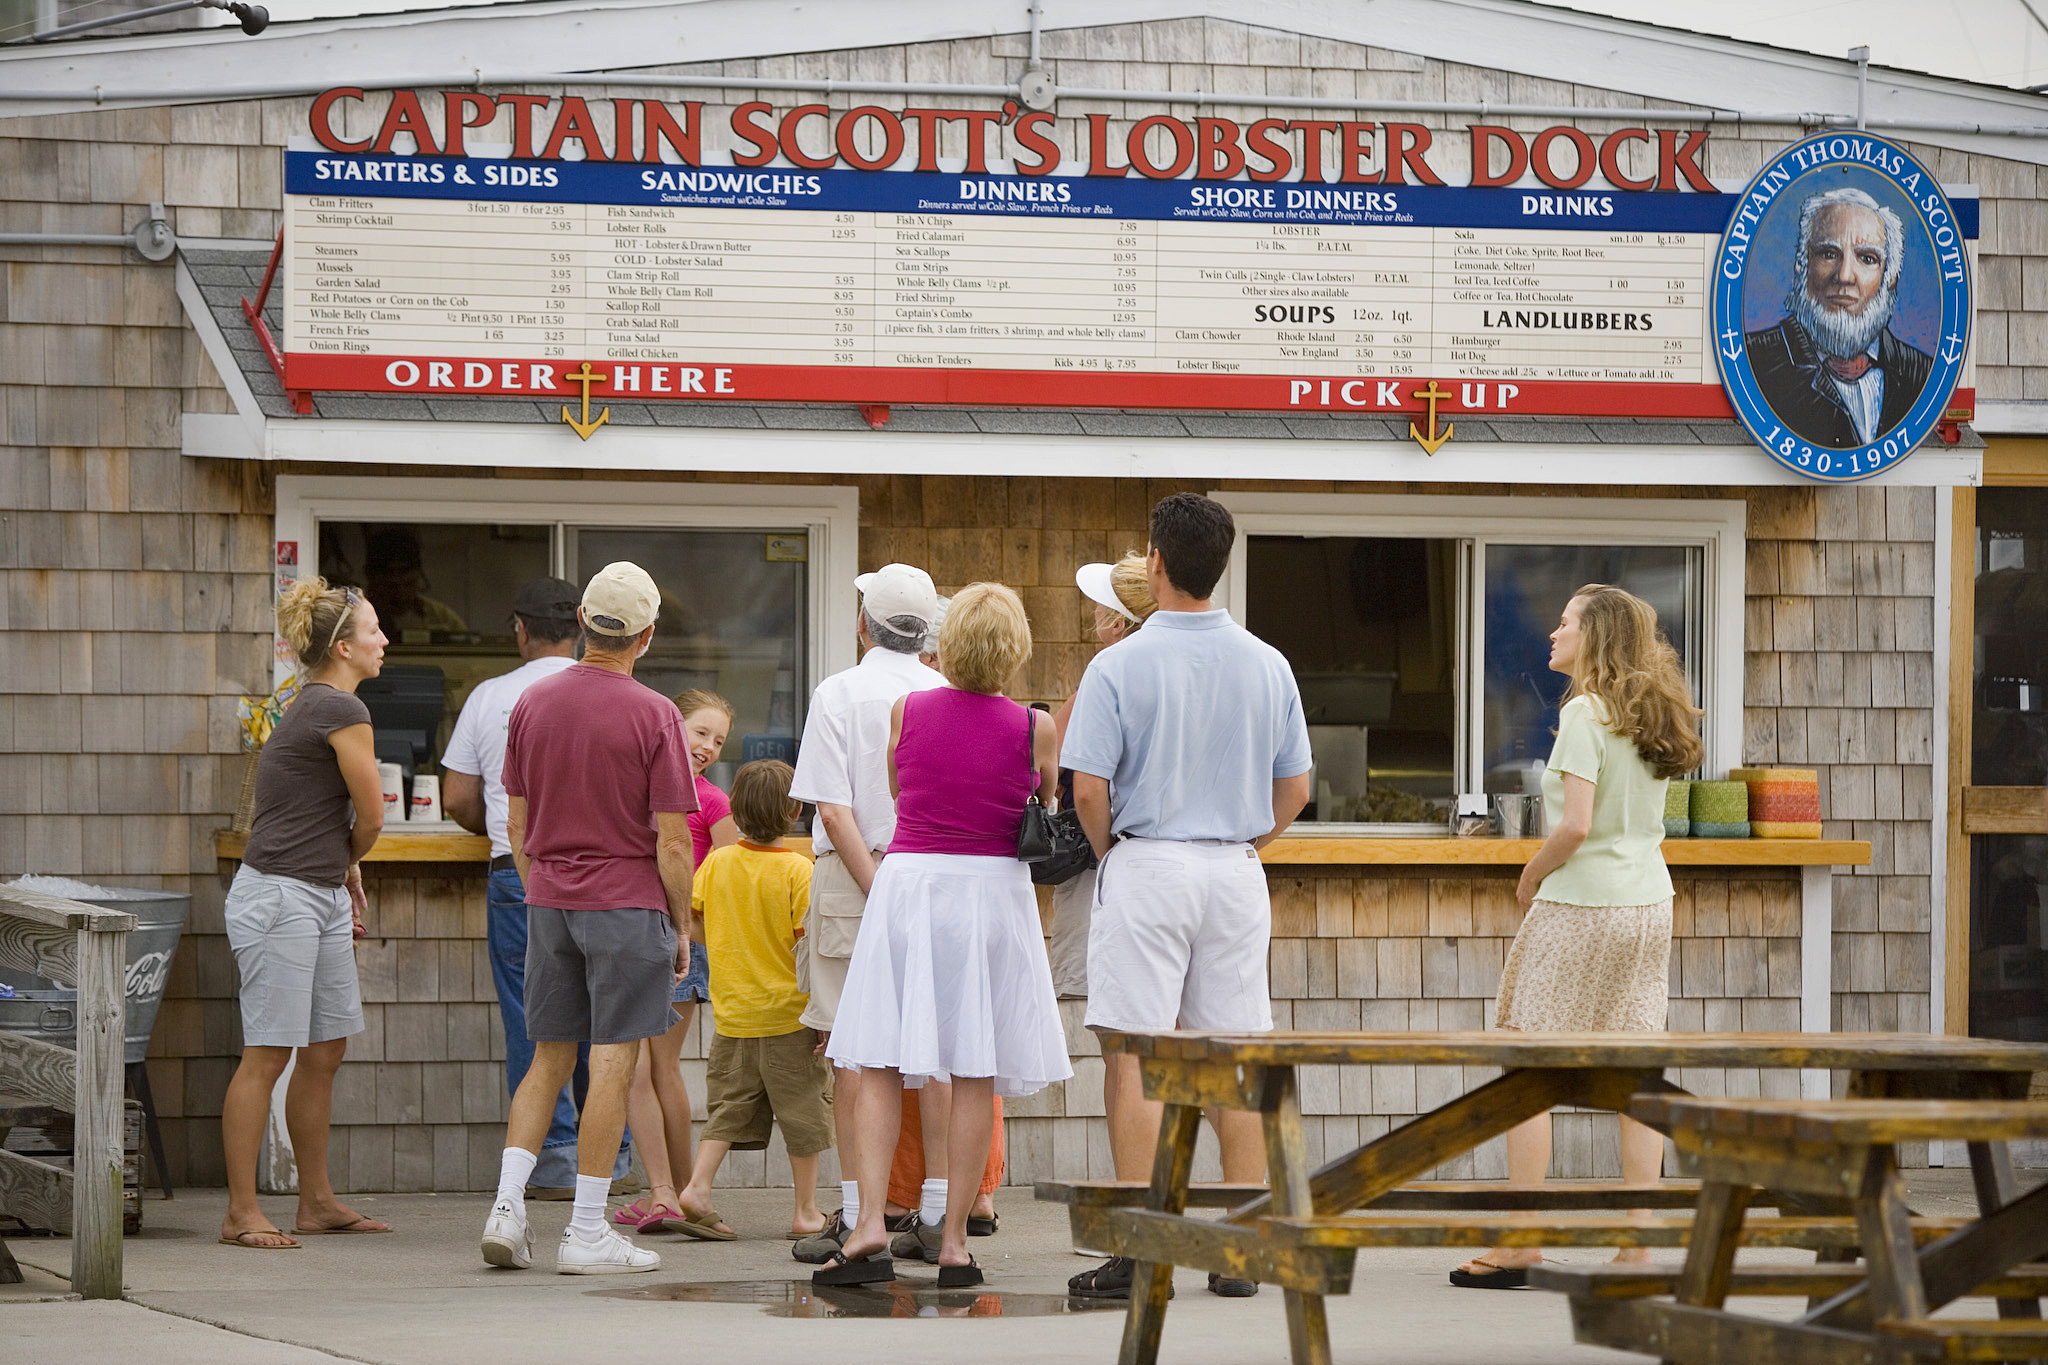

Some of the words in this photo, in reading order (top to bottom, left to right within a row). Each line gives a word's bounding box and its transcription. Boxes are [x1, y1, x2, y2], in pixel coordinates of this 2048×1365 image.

[309, 86, 705, 167] CAPTAIN
[730, 100, 1061, 178] SCOTT'S
[1086, 113, 1448, 189] LOBSTER
[1466, 124, 1723, 194] DOCK
[315, 160, 449, 184] STARTERS
[455, 162, 471, 186] &
[484, 166, 559, 188] SIDES
[641, 171, 821, 195] SANDWICHES
[960, 180, 1071, 202] DINNERS
[309, 198, 335, 208] Clam
[339, 199, 373, 209] Fritters
[1191, 188, 1275, 209] SHORE
[1287, 190, 1398, 211] DINNERS
[1522, 195, 1614, 216] DRINKS
[608, 208, 627, 218] Fish
[630, 208, 675, 219] Sandwich
[835, 214, 855, 224] 4.50
[1173, 207, 1200, 218] Served
[1253, 209, 1273, 219] Corn
[1274, 211, 1285, 219] on
[1286, 210, 1298, 220] the
[1318, 211, 1333, 220] and
[1335, 210, 1363, 222] French
[1364, 212, 1383, 222] Fries
[1385, 214, 1393, 222] or
[1395, 213, 1414, 222] Reds
[1723, 163, 1791, 280] CAPTAIN
[1792, 139, 1906, 176] THOMAS
[1921, 194, 1964, 284] SCOTT
[316, 214, 352, 227] Shrimp
[354, 216, 393, 226] Cocktail
[552, 222, 571, 231] 5.95
[896, 215, 915, 225] Fish
[918, 216, 925, 226] N
[927, 216, 952, 228] Chips
[1120, 222, 1137, 232] 7.95
[607, 223, 640, 233] Lobster
[644, 224, 666, 234] Rolls
[832, 229, 855, 239] 12.95
[896, 231, 920, 241] Fried
[922, 232, 964, 242] Calamari
[1117, 237, 1137, 247] 6.95
[1273, 226, 1320, 236] LOBSTER
[1454, 230, 1475, 240] Soda
[315, 246, 358, 256] Steamers
[551, 254, 571, 263] 5.95
[895, 247, 912, 257] Sea
[914, 247, 950, 258] Scallops
[1113, 252, 1137, 262] 10.95
[317, 263, 353, 273] Mussels
[551, 270, 571, 279] 3.95
[895, 262, 920, 272] Clam
[923, 262, 949, 274] Strips
[1118, 268, 1137, 277] 7.95
[316, 278, 351, 288] Garden
[354, 279, 380, 289] Salad
[552, 284, 571, 294] 2.95
[607, 270, 632, 280] Clam
[635, 271, 658, 283] Strip
[661, 272, 679, 281] Roll
[835, 276, 855, 286] 5.95
[1454, 276, 1472, 286] Iced
[1493, 277, 1511, 287] Iced
[1512, 277, 1540, 287] Coffee
[1667, 280, 1685, 290] 1.50
[608, 286, 637, 296] Whole
[640, 287, 663, 299] Belly
[666, 287, 691, 297] Clam
[694, 287, 713, 298] Roll
[835, 292, 854, 301] 8.95
[896, 293, 919, 303] Fried
[921, 294, 955, 306] Shrimp
[1117, 298, 1137, 308] 7.95
[1242, 287, 1267, 296] Other
[1270, 288, 1289, 297] sizes
[1291, 288, 1309, 297] also
[1312, 288, 1350, 298] available
[310, 293, 329, 303] Red
[333, 294, 371, 304] Potatoes
[376, 296, 386, 305] or
[390, 296, 414, 305] Corn
[418, 298, 429, 306] on
[432, 296, 447, 306] the
[450, 297, 468, 307] Cob
[545, 300, 565, 310] 1.50
[606, 302, 639, 313] Scallop
[642, 302, 660, 312] Roll
[835, 307, 855, 317] 9.50
[896, 308, 938, 321] Captain's
[940, 309, 972, 319] Combo
[1112, 313, 1136, 323] 12.95
[1255, 305, 1335, 324] SOUPS
[1483, 310, 1653, 331] LANDLUBBERS
[310, 325, 343, 336] French
[347, 326, 369, 336] Fries
[544, 332, 564, 341] 3.25
[607, 318, 629, 328] Crab
[632, 318, 658, 328] Salad
[661, 319, 679, 329] Roll
[835, 323, 853, 333] 7.50
[608, 332, 631, 343] Tuna
[635, 333, 660, 343] Salad
[835, 338, 854, 347] 3.95
[1175, 331, 1200, 341] Clam
[1202, 331, 1241, 341] Chowder
[1277, 332, 1305, 342] Rhode
[1308, 333, 1335, 343] Island
[1355, 334, 1374, 344] 2.50
[1394, 335, 1412, 344] 6.50
[1451, 336, 1501, 348] Hamburger
[1664, 340, 1682, 350] 2.95
[310, 341, 340, 352] Onion
[343, 342, 370, 353] Rings
[544, 347, 564, 357] 2.50
[608, 348, 638, 359] Grilled
[641, 349, 678, 359] Chicken
[834, 353, 854, 363] 5.95
[1280, 347, 1299, 357] New
[1302, 348, 1339, 359] England
[1355, 349, 1374, 358] 3.50
[1393, 350, 1412, 359] 9.50
[897, 354, 934, 365] Chicken
[937, 355, 972, 365] Tenders
[1055, 358, 1073, 368] Kids
[1079, 359, 1098, 368] 4.95
[1117, 359, 1137, 368] 7.95
[1451, 351, 1466, 361] Hot
[1468, 352, 1486, 363] Dog
[1664, 355, 1682, 365] 2.75
[1177, 360, 1209, 370] Lobster
[1212, 361, 1240, 372] Bisque
[1357, 365, 1375, 374] 5.50
[1390, 365, 1413, 375] 15.95
[386, 360, 557, 390] ORDER
[614, 366, 735, 394] HERE
[1290, 380, 1402, 407] PICK
[1462, 383, 1520, 409] UP
[1765, 427, 1912, 474] 1830-1907
